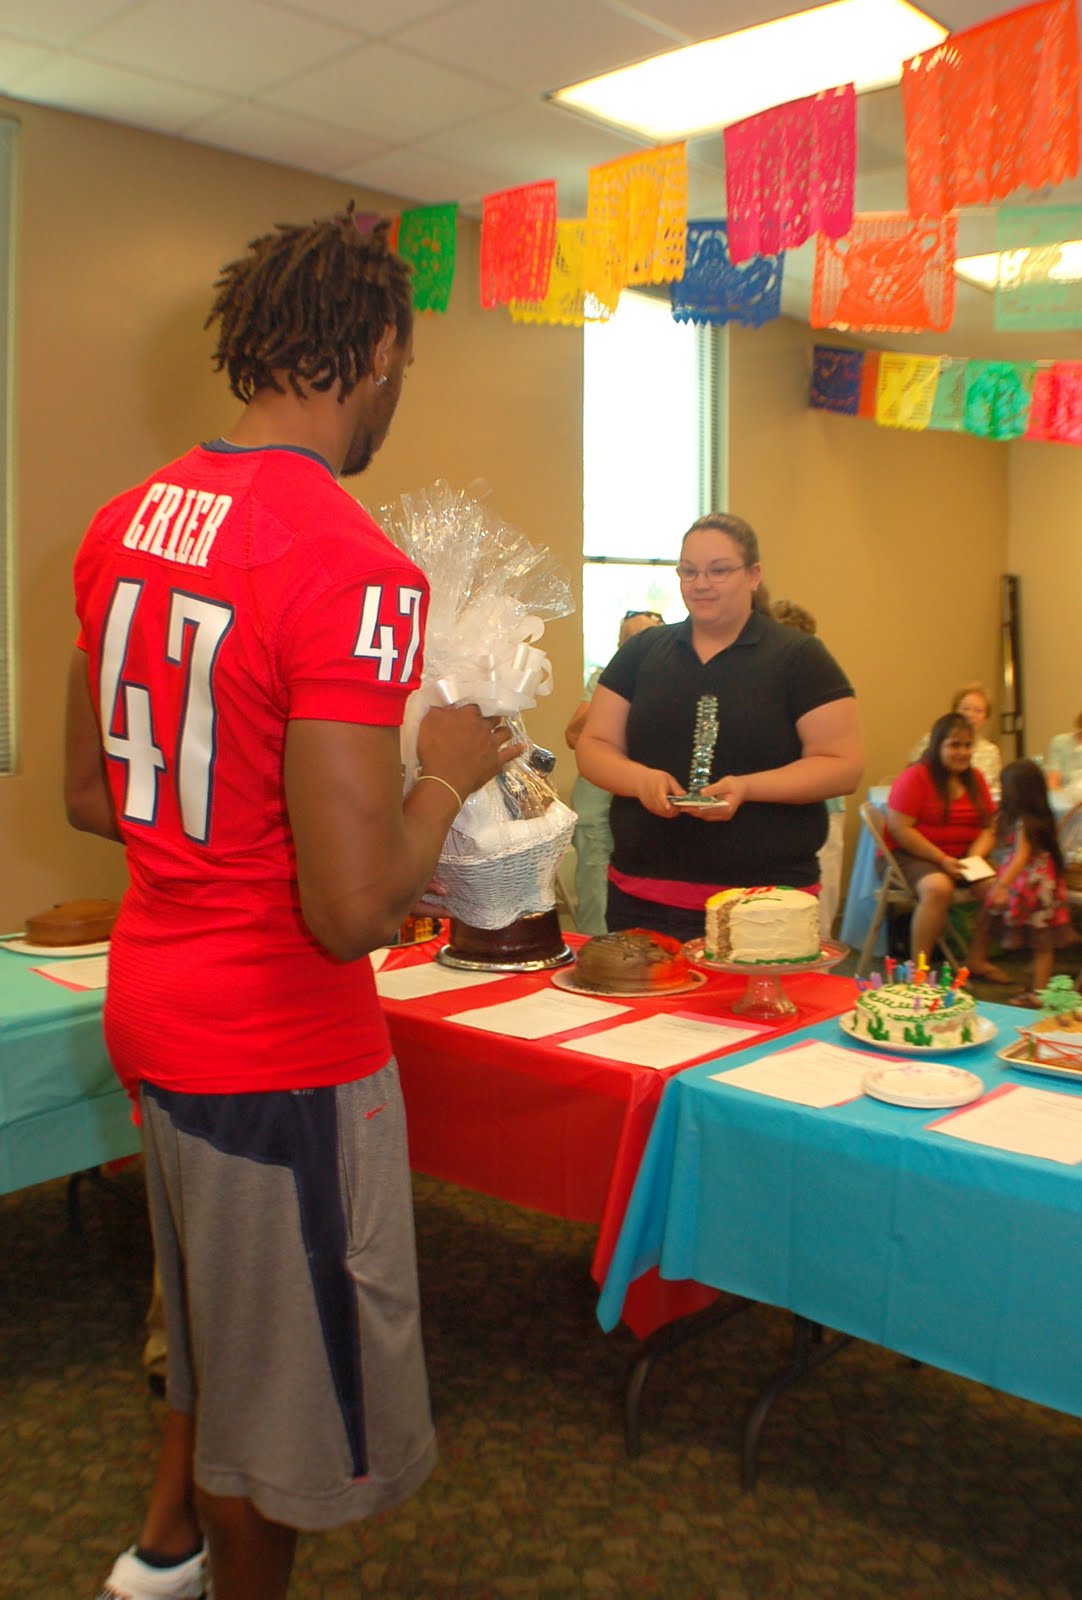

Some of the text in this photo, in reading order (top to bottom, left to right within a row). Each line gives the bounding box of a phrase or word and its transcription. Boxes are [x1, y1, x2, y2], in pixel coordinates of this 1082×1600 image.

[122, 482, 233, 568] CRIER
[352, 585, 422, 684] 47
[100, 577, 235, 845] 47
